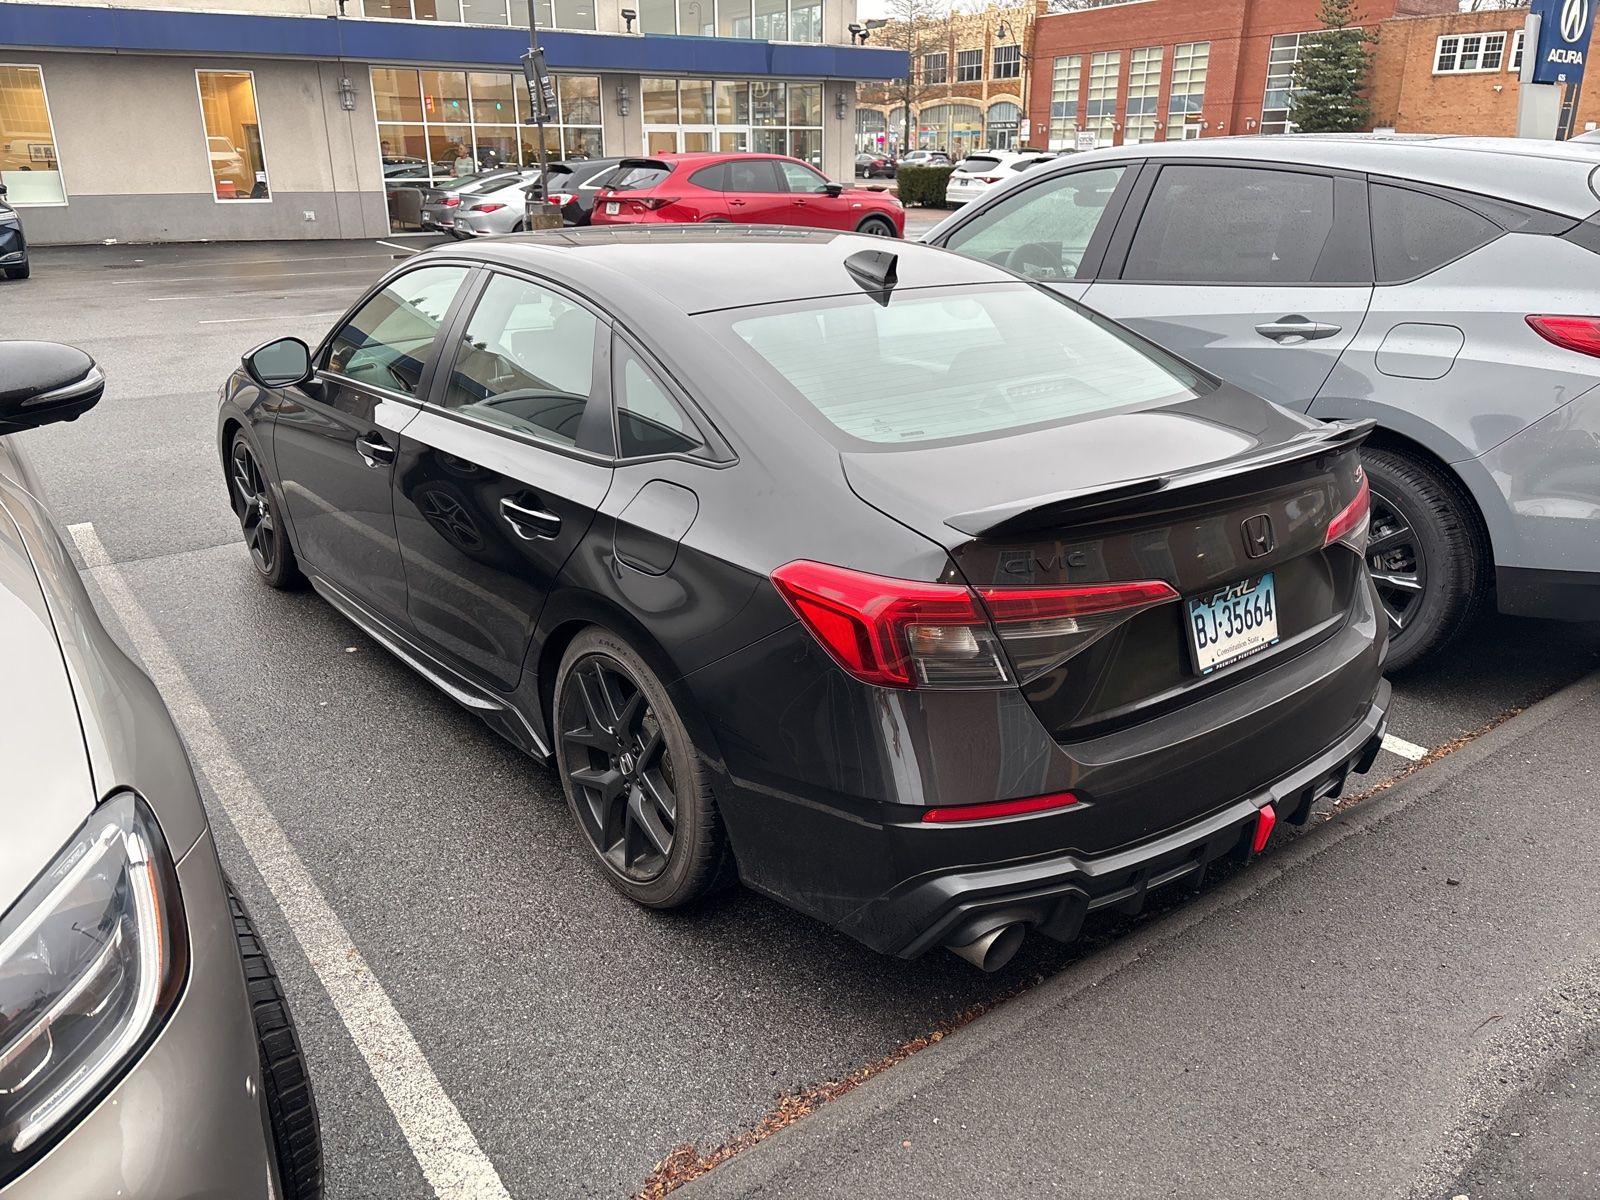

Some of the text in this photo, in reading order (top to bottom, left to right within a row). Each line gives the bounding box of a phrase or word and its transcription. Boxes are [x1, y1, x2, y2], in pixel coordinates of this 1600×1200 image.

[1547, 48, 1583, 65] ACURA
[1005, 551, 1087, 575] CIVIC
[1215, 643, 1269, 670] PREMIUM PERFORMANCE
[1216, 635, 1260, 657] Constitution State
